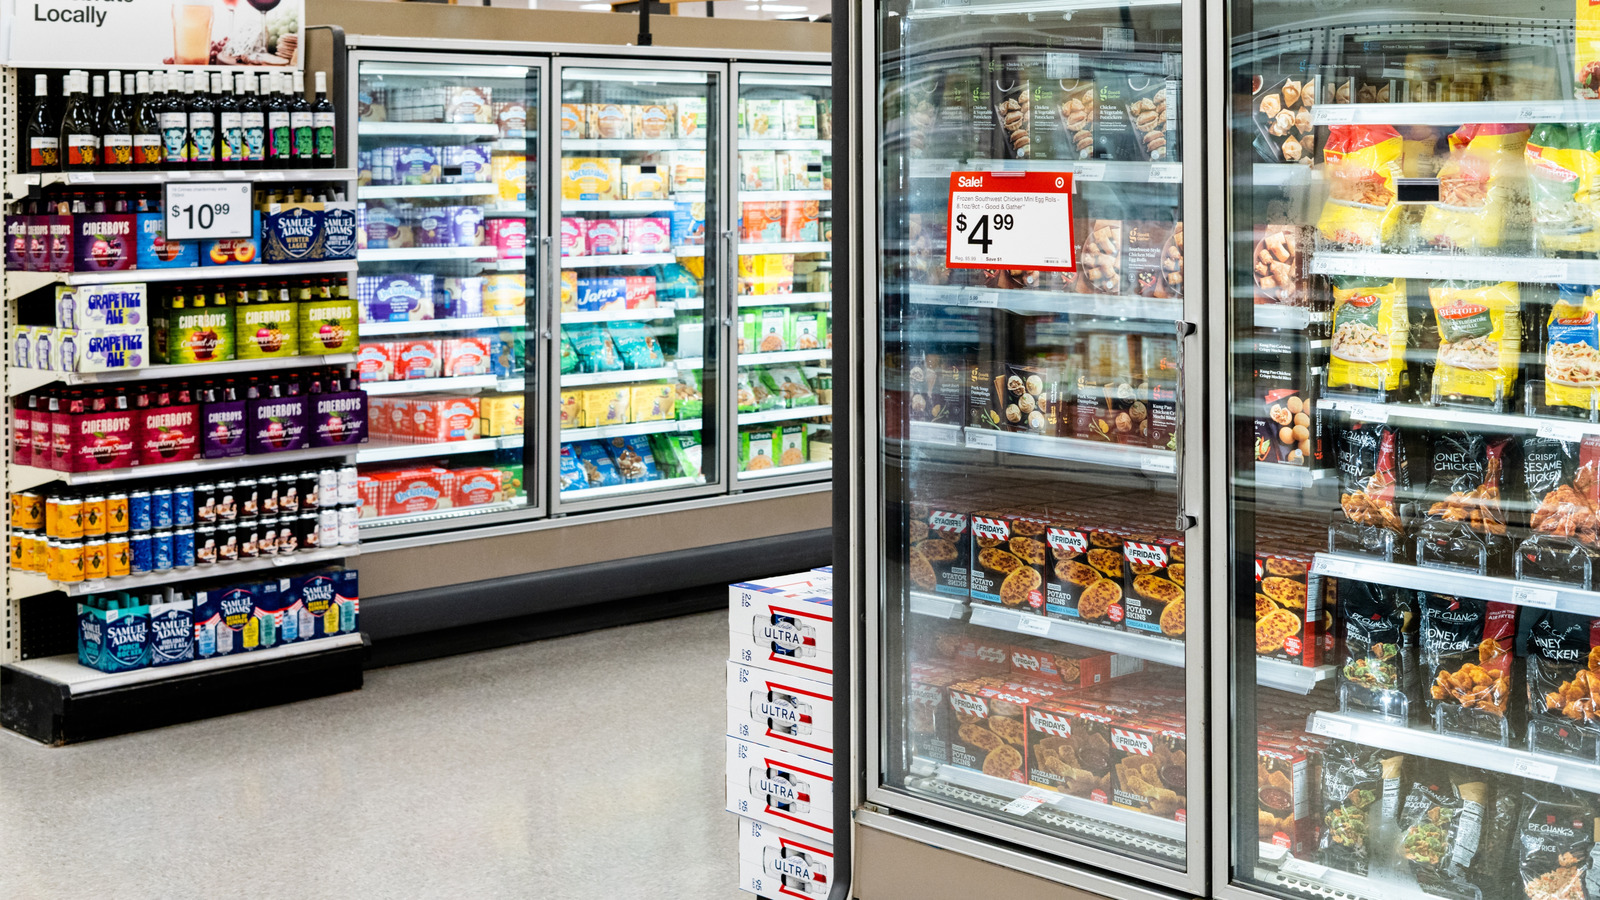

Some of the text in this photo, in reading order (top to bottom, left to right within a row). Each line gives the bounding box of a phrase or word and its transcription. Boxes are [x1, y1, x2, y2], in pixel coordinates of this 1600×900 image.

[34, 4, 108, 28] Locally
[958, 176, 984, 188] Sale!
[83, 222, 130, 236] CIDERBOYS
[278, 216, 317, 229] SAMUEL
[281, 226, 314, 238] ADAMS
[325, 226, 354, 237] ADAMS
[286, 236, 310, 244] WINTER
[288, 242, 308, 250] LAGER
[578, 287, 619, 306] Jams
[626, 285, 650, 301] ams
[88, 293, 141, 310] GRAPE FIZZ
[106, 309, 124, 325] ALE
[246, 310, 291, 325] CIDERBOYS
[309, 307, 352, 321] CIDERBOYS
[179, 314, 227, 329] CIDERBOYS
[89, 334, 143, 353] GRAPE FIZZ
[181, 340, 207, 349] Caramel
[107, 352, 125, 368] ALE
[258, 403, 302, 419] CIDERBOYS
[318, 398, 362, 414] CIDERBOYS
[147, 412, 193, 430] CIDERBOYS
[209, 411, 243, 424] CIDERBOYS
[81, 418, 130, 435] CIDERBOYS
[1528, 453, 1558, 462] CRISPY
[1434, 462, 1483, 473] CHICKEN
[1524, 461, 1563, 473] SESAME
[979, 524, 1004, 535] FRIDAYS
[1055, 536, 1082, 546] FRIDAYS
[1133, 550, 1161, 561] FRIDAYS
[972, 577, 994, 587] POTATO
[972, 584, 989, 592] SKINS
[303, 584, 334, 597] SAMUEL
[1047, 590, 1072, 600] POTATO
[221, 597, 254, 610] SAMUEL
[306, 592, 332, 603] ADAMS
[1047, 597, 1066, 606] SKINS
[224, 605, 251, 617] ADAMS
[1126, 605, 1152, 616] POTATO
[1126, 612, 1147, 622] SKINS
[107, 622, 149, 638] SAMUEL
[152, 617, 193, 633] SAMUEL
[112, 634, 146, 648] ADAMS
[156, 629, 190, 642] ADAMS
[162, 638, 186, 646] HOLIDAY
[764, 626, 800, 645] ULTRA
[117, 648, 143, 658] ROCKER
[118, 643, 140, 652] PORCH
[746, 650, 752, 662] 95
[742, 669, 750, 684] 2.6
[957, 699, 983, 712] FRIDAYS
[761, 703, 796, 722] ULTRA
[742, 724, 750, 737] 95
[1038, 718, 1066, 732] FRIDAYS
[1119, 737, 1148, 750] FRIDAYS
[741, 745, 749, 759] 2.6
[952, 751, 976, 762] POTATO
[952, 757, 972, 767] SKINS
[1031, 768, 1066, 784] MOZZARELLA
[1031, 775, 1050, 785] STICKS
[760, 780, 794, 800] ULTRA
[1114, 789, 1149, 804] MOZZARELLA
[742, 800, 749, 813] 95
[1114, 796, 1133, 806] STICKS
[755, 824, 763, 838] 2.6
[1541, 825, 1574, 838] CHANG'S
[775, 859, 810, 880] ULTRA
[755, 879, 763, 892] 95
